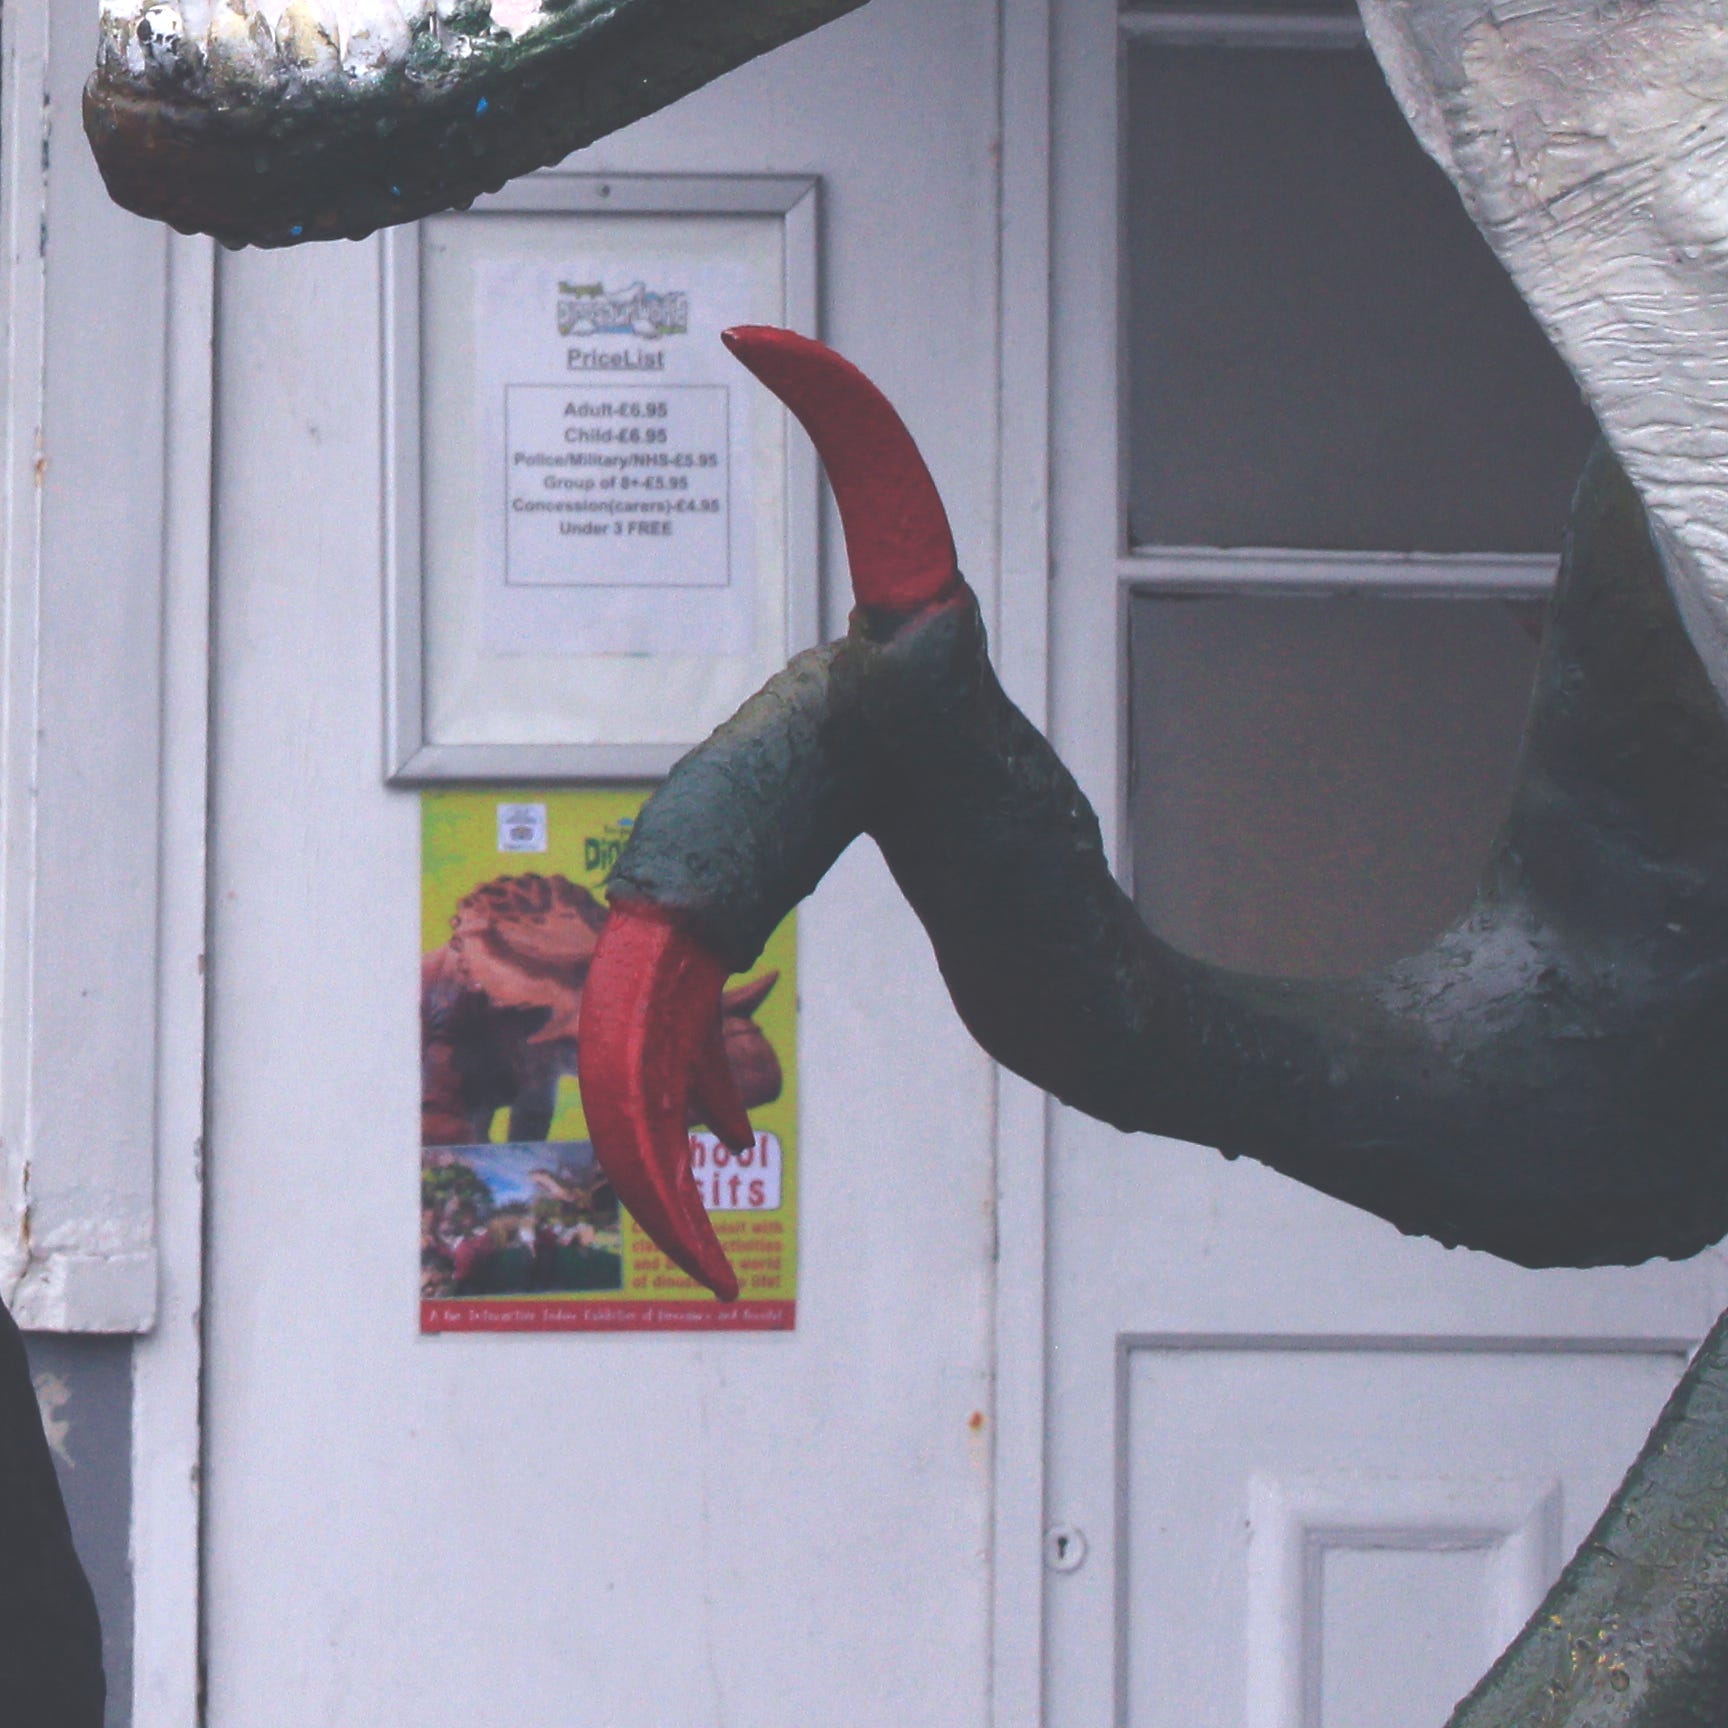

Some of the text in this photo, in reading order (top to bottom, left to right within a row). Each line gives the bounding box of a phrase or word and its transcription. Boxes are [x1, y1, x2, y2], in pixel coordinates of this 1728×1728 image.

[543, 475, 594, 493] Group
[600, 475, 616, 491] of
[559, 520, 609, 536] Under
[627, 520, 673, 536] FREE
